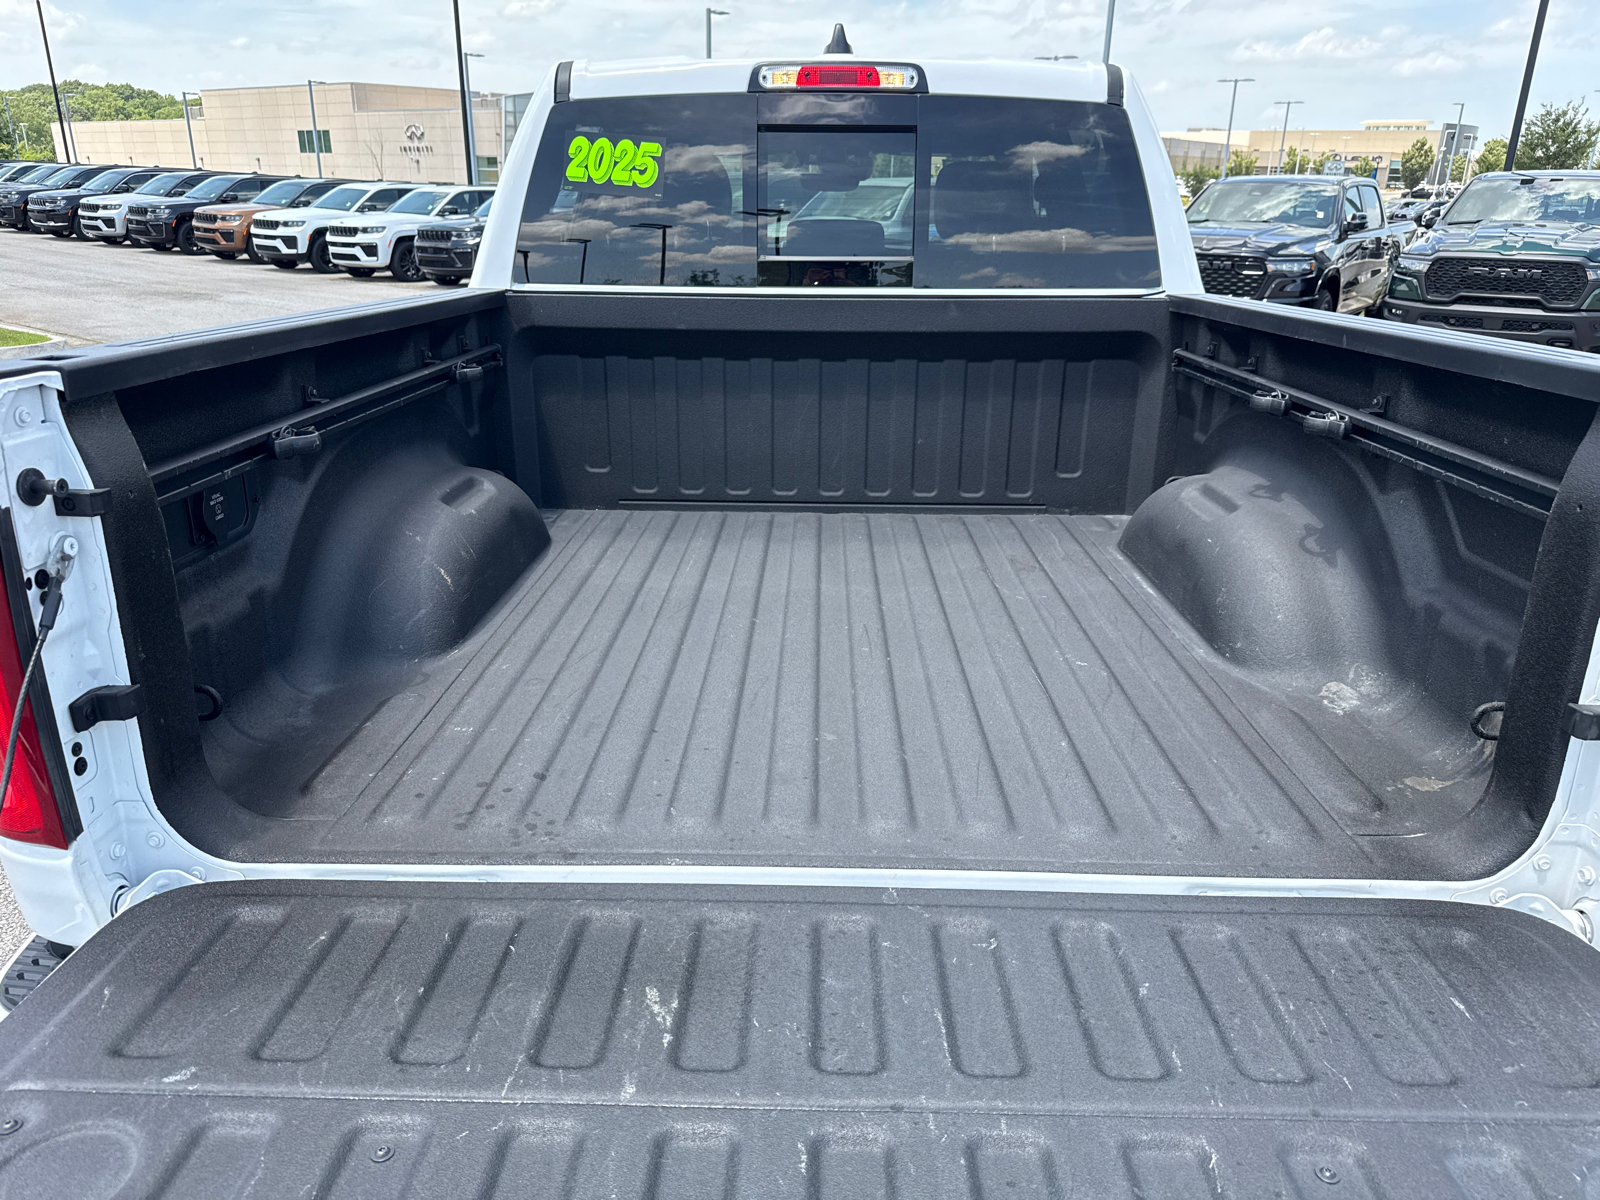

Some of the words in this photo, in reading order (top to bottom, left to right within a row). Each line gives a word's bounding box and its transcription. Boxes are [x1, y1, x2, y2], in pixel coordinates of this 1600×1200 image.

[399, 145, 433, 153] INFINITI
[566, 135, 662, 188] 2025
[1198, 260, 1232, 269] AM
[1467, 266, 1543, 280] RAM
